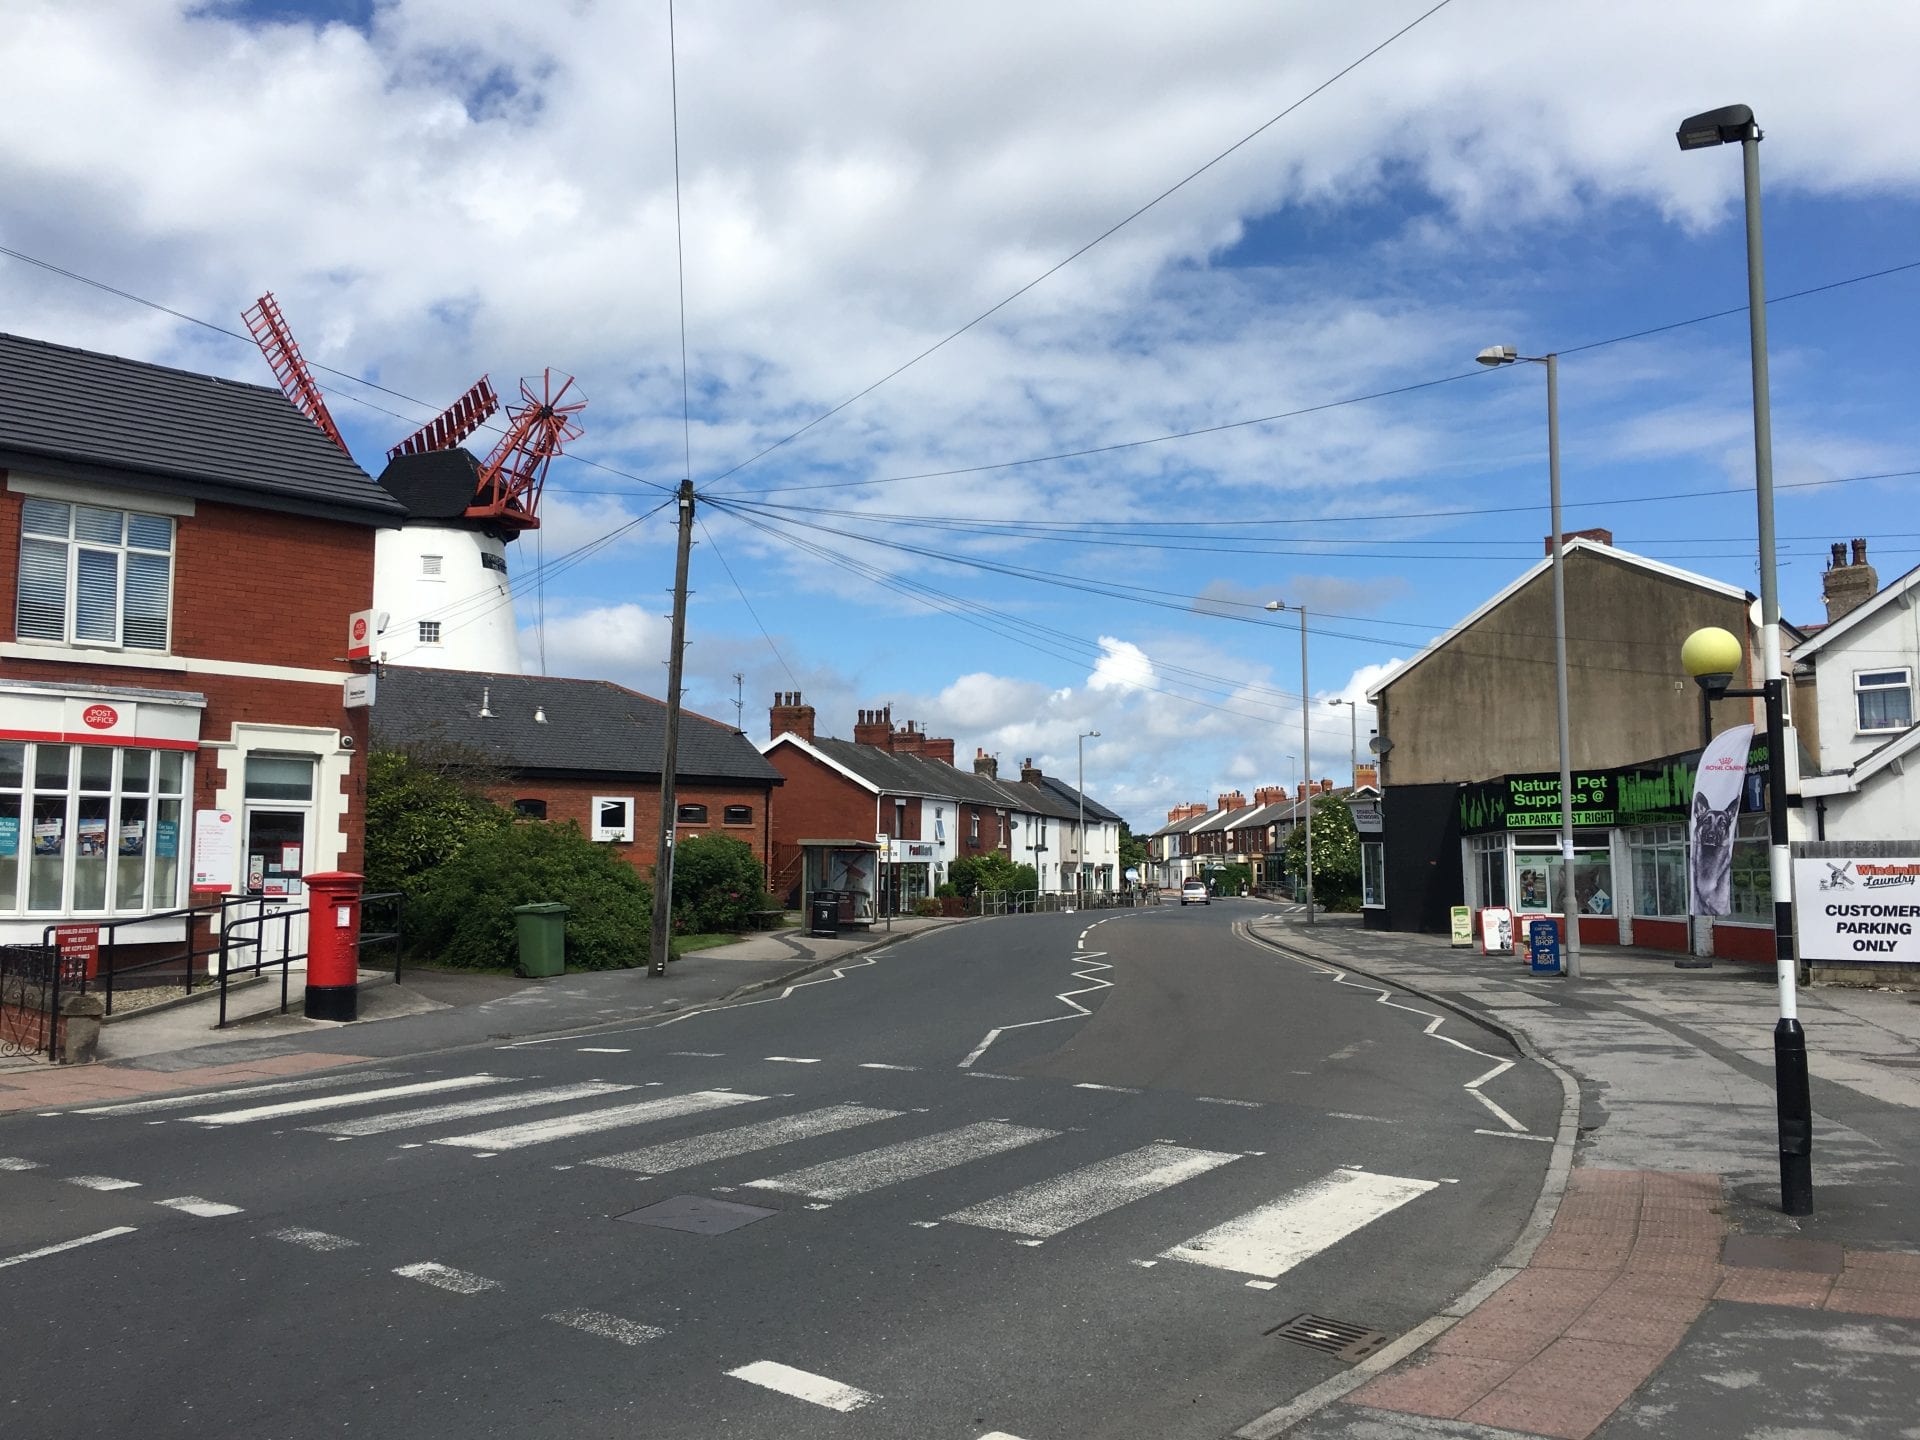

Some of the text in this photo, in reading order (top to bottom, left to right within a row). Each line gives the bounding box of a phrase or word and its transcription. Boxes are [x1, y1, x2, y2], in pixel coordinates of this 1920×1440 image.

[86, 716, 114, 724] OFFICE
[1510, 776, 1608, 792] Natura Pet
[1514, 790, 1604, 807] Supples @
[1508, 815, 1526, 825] CAR
[1529, 814, 1556, 824] PARK
[1556, 812, 1582, 823] FST
[1585, 812, 1613, 823] RIGHT
[1863, 874, 1915, 887] Laundry
[1825, 904, 1920, 917] CUSTOMER
[1836, 922, 1912, 935] PARKING
[1852, 939, 1898, 952] ONLY
